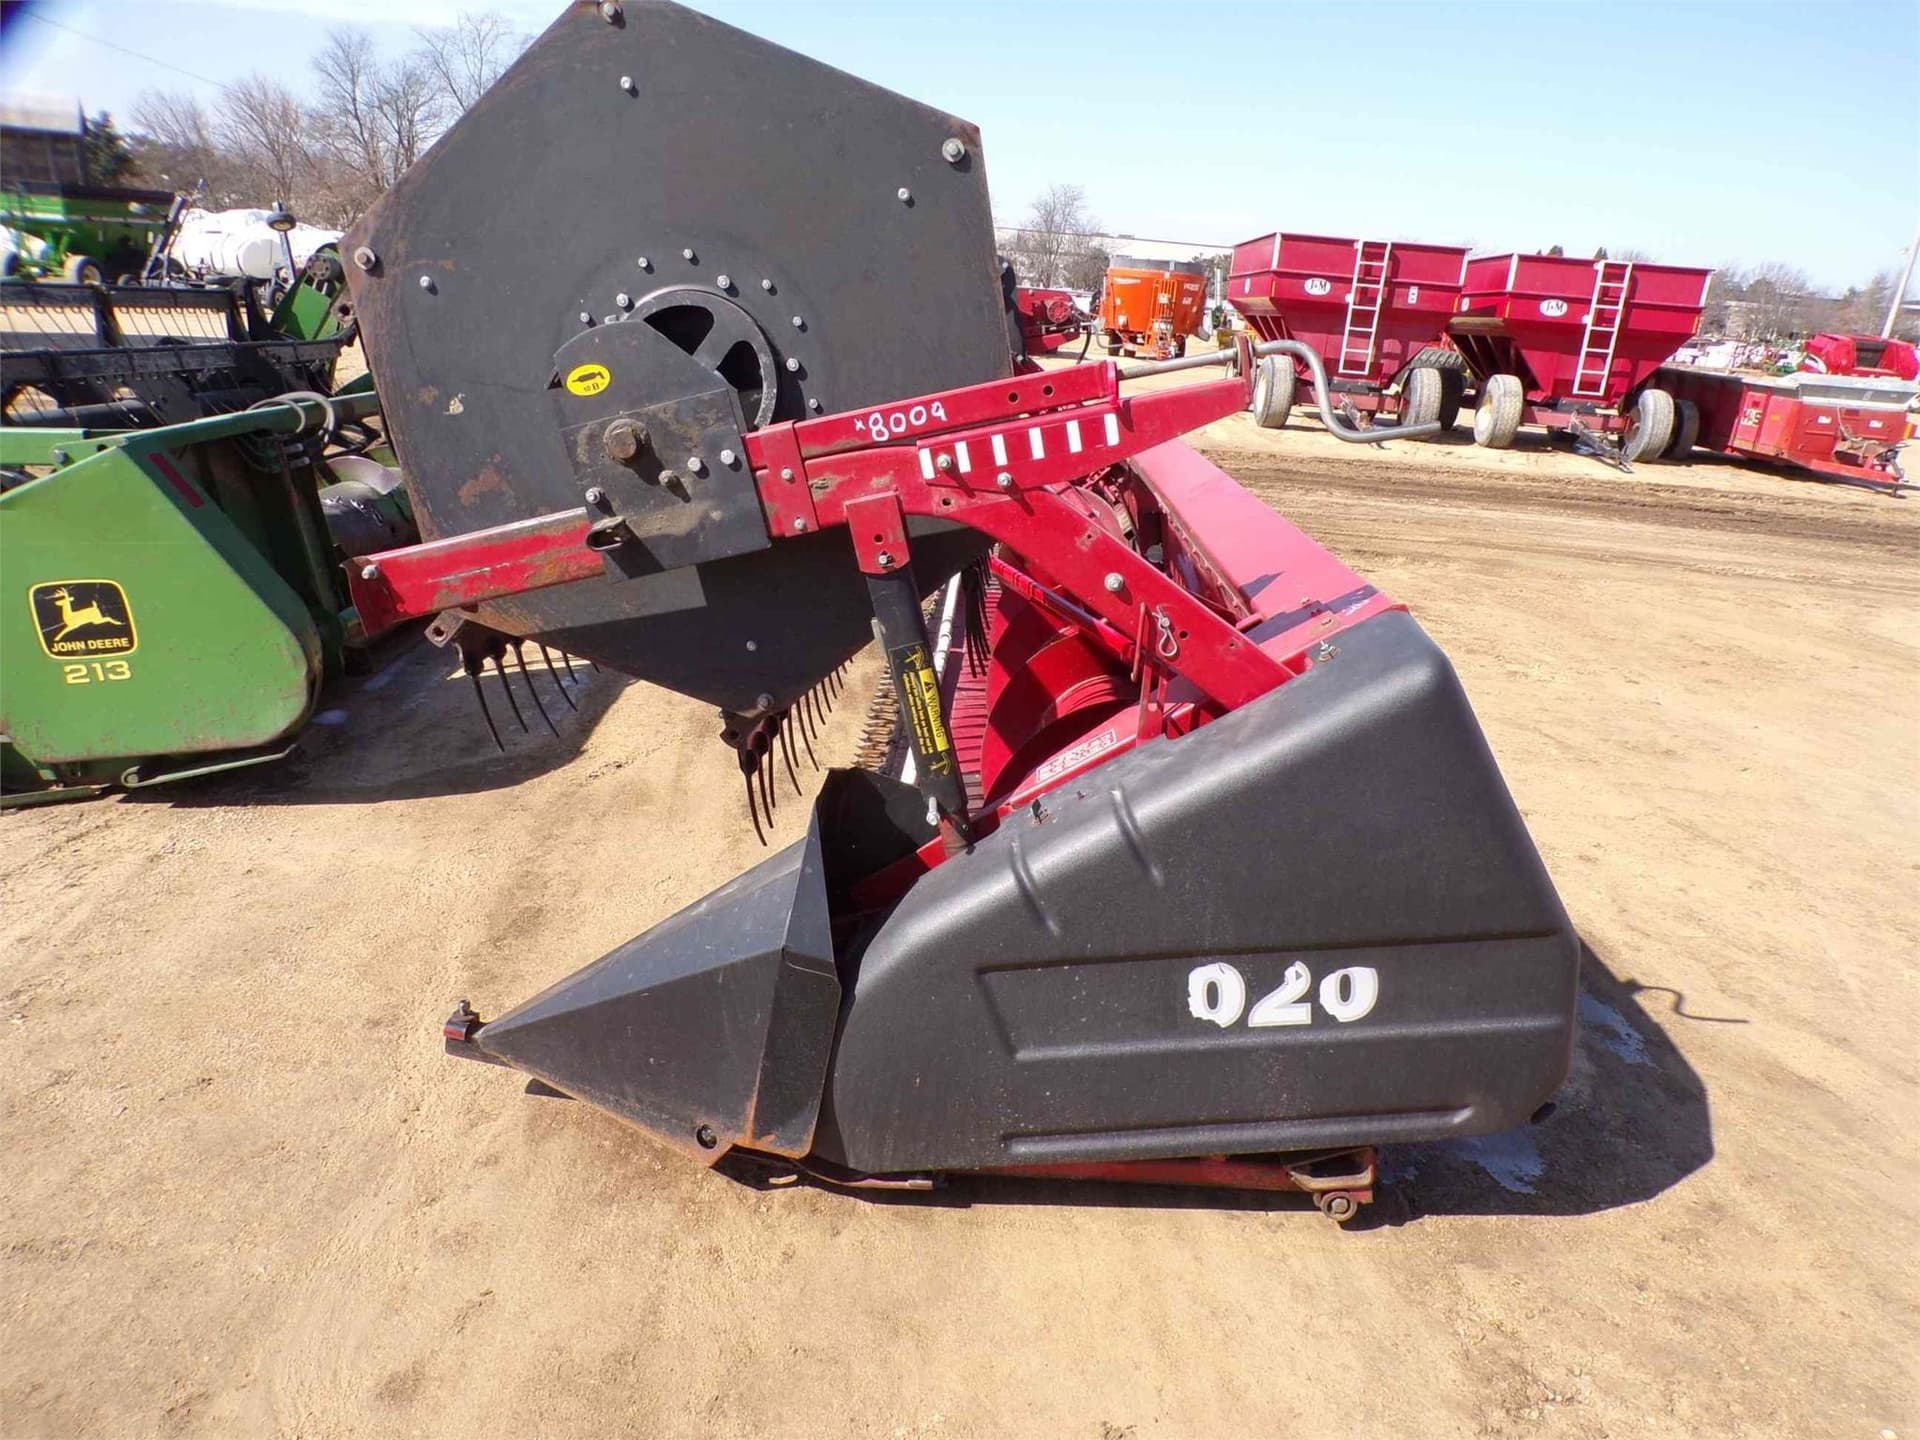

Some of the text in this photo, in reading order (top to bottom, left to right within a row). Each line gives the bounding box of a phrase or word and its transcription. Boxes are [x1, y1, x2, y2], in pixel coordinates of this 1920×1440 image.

[51, 638, 130, 653] JOHN DEERE
[64, 660, 131, 684] 213
[927, 694, 945, 738] WARNING
[1187, 960, 1379, 1029] 020
